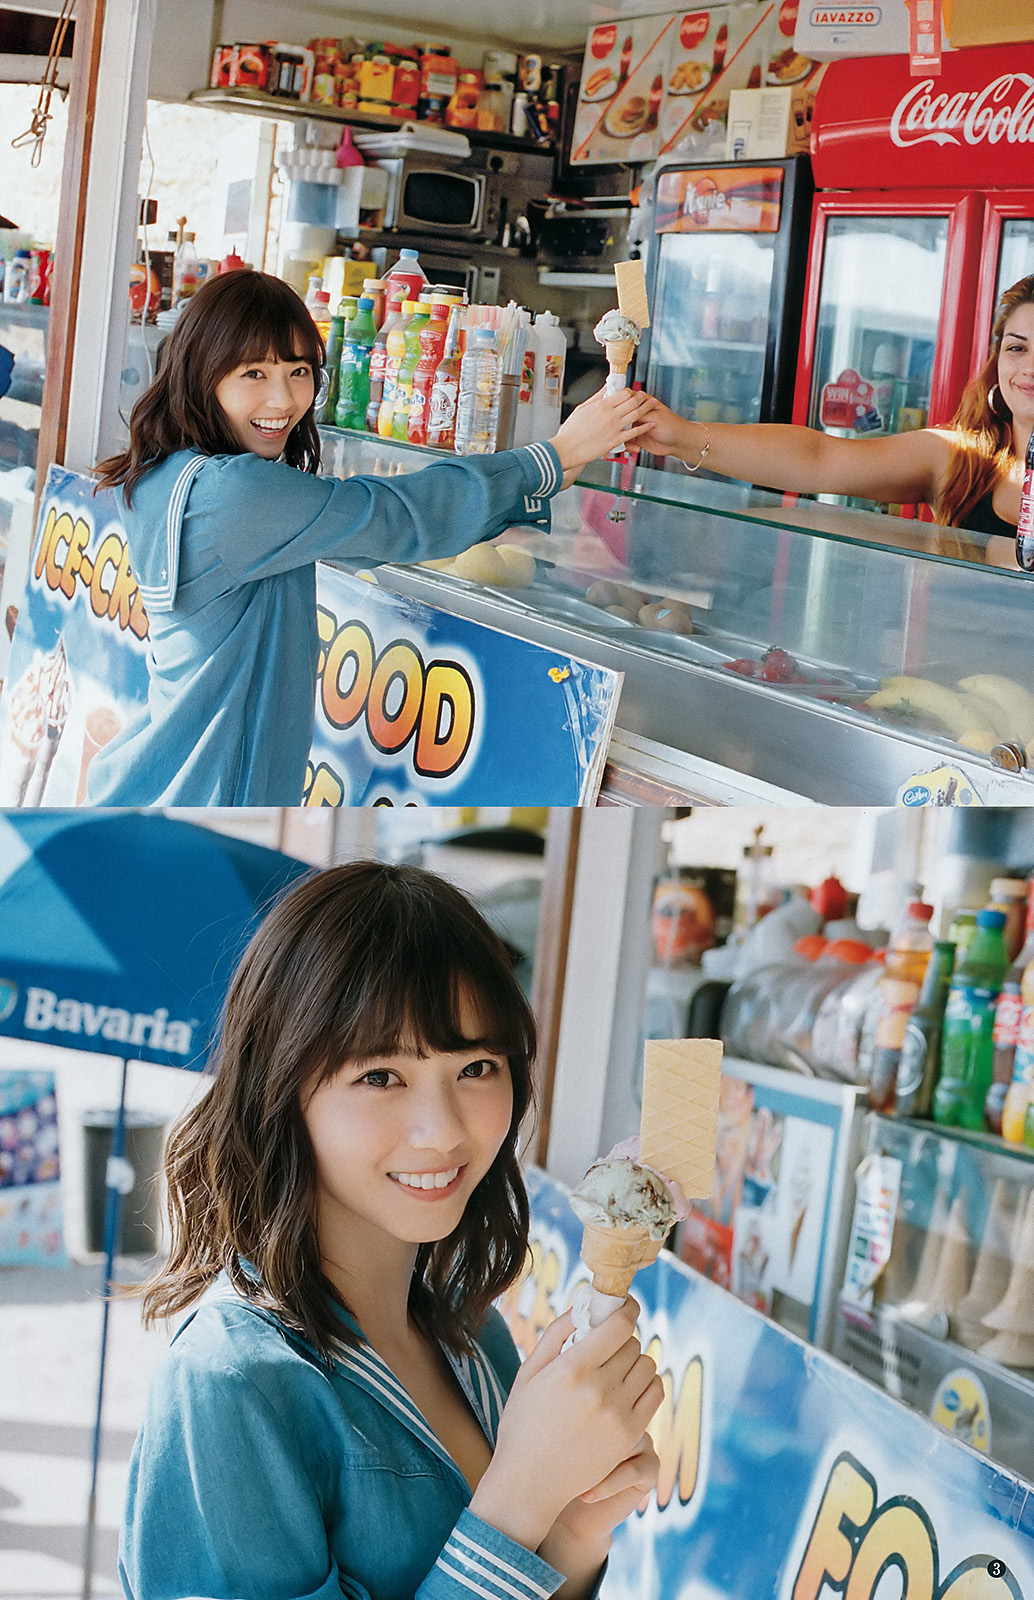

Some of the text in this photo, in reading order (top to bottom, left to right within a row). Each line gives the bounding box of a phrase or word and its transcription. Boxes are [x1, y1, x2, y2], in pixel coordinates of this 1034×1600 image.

[889, 72, 1034, 147] Coca-Cola
[827, 386, 849, 400] WIN
[24, 986, 192, 1055] Bavaria
[792, 1450, 1024, 1600] FO
